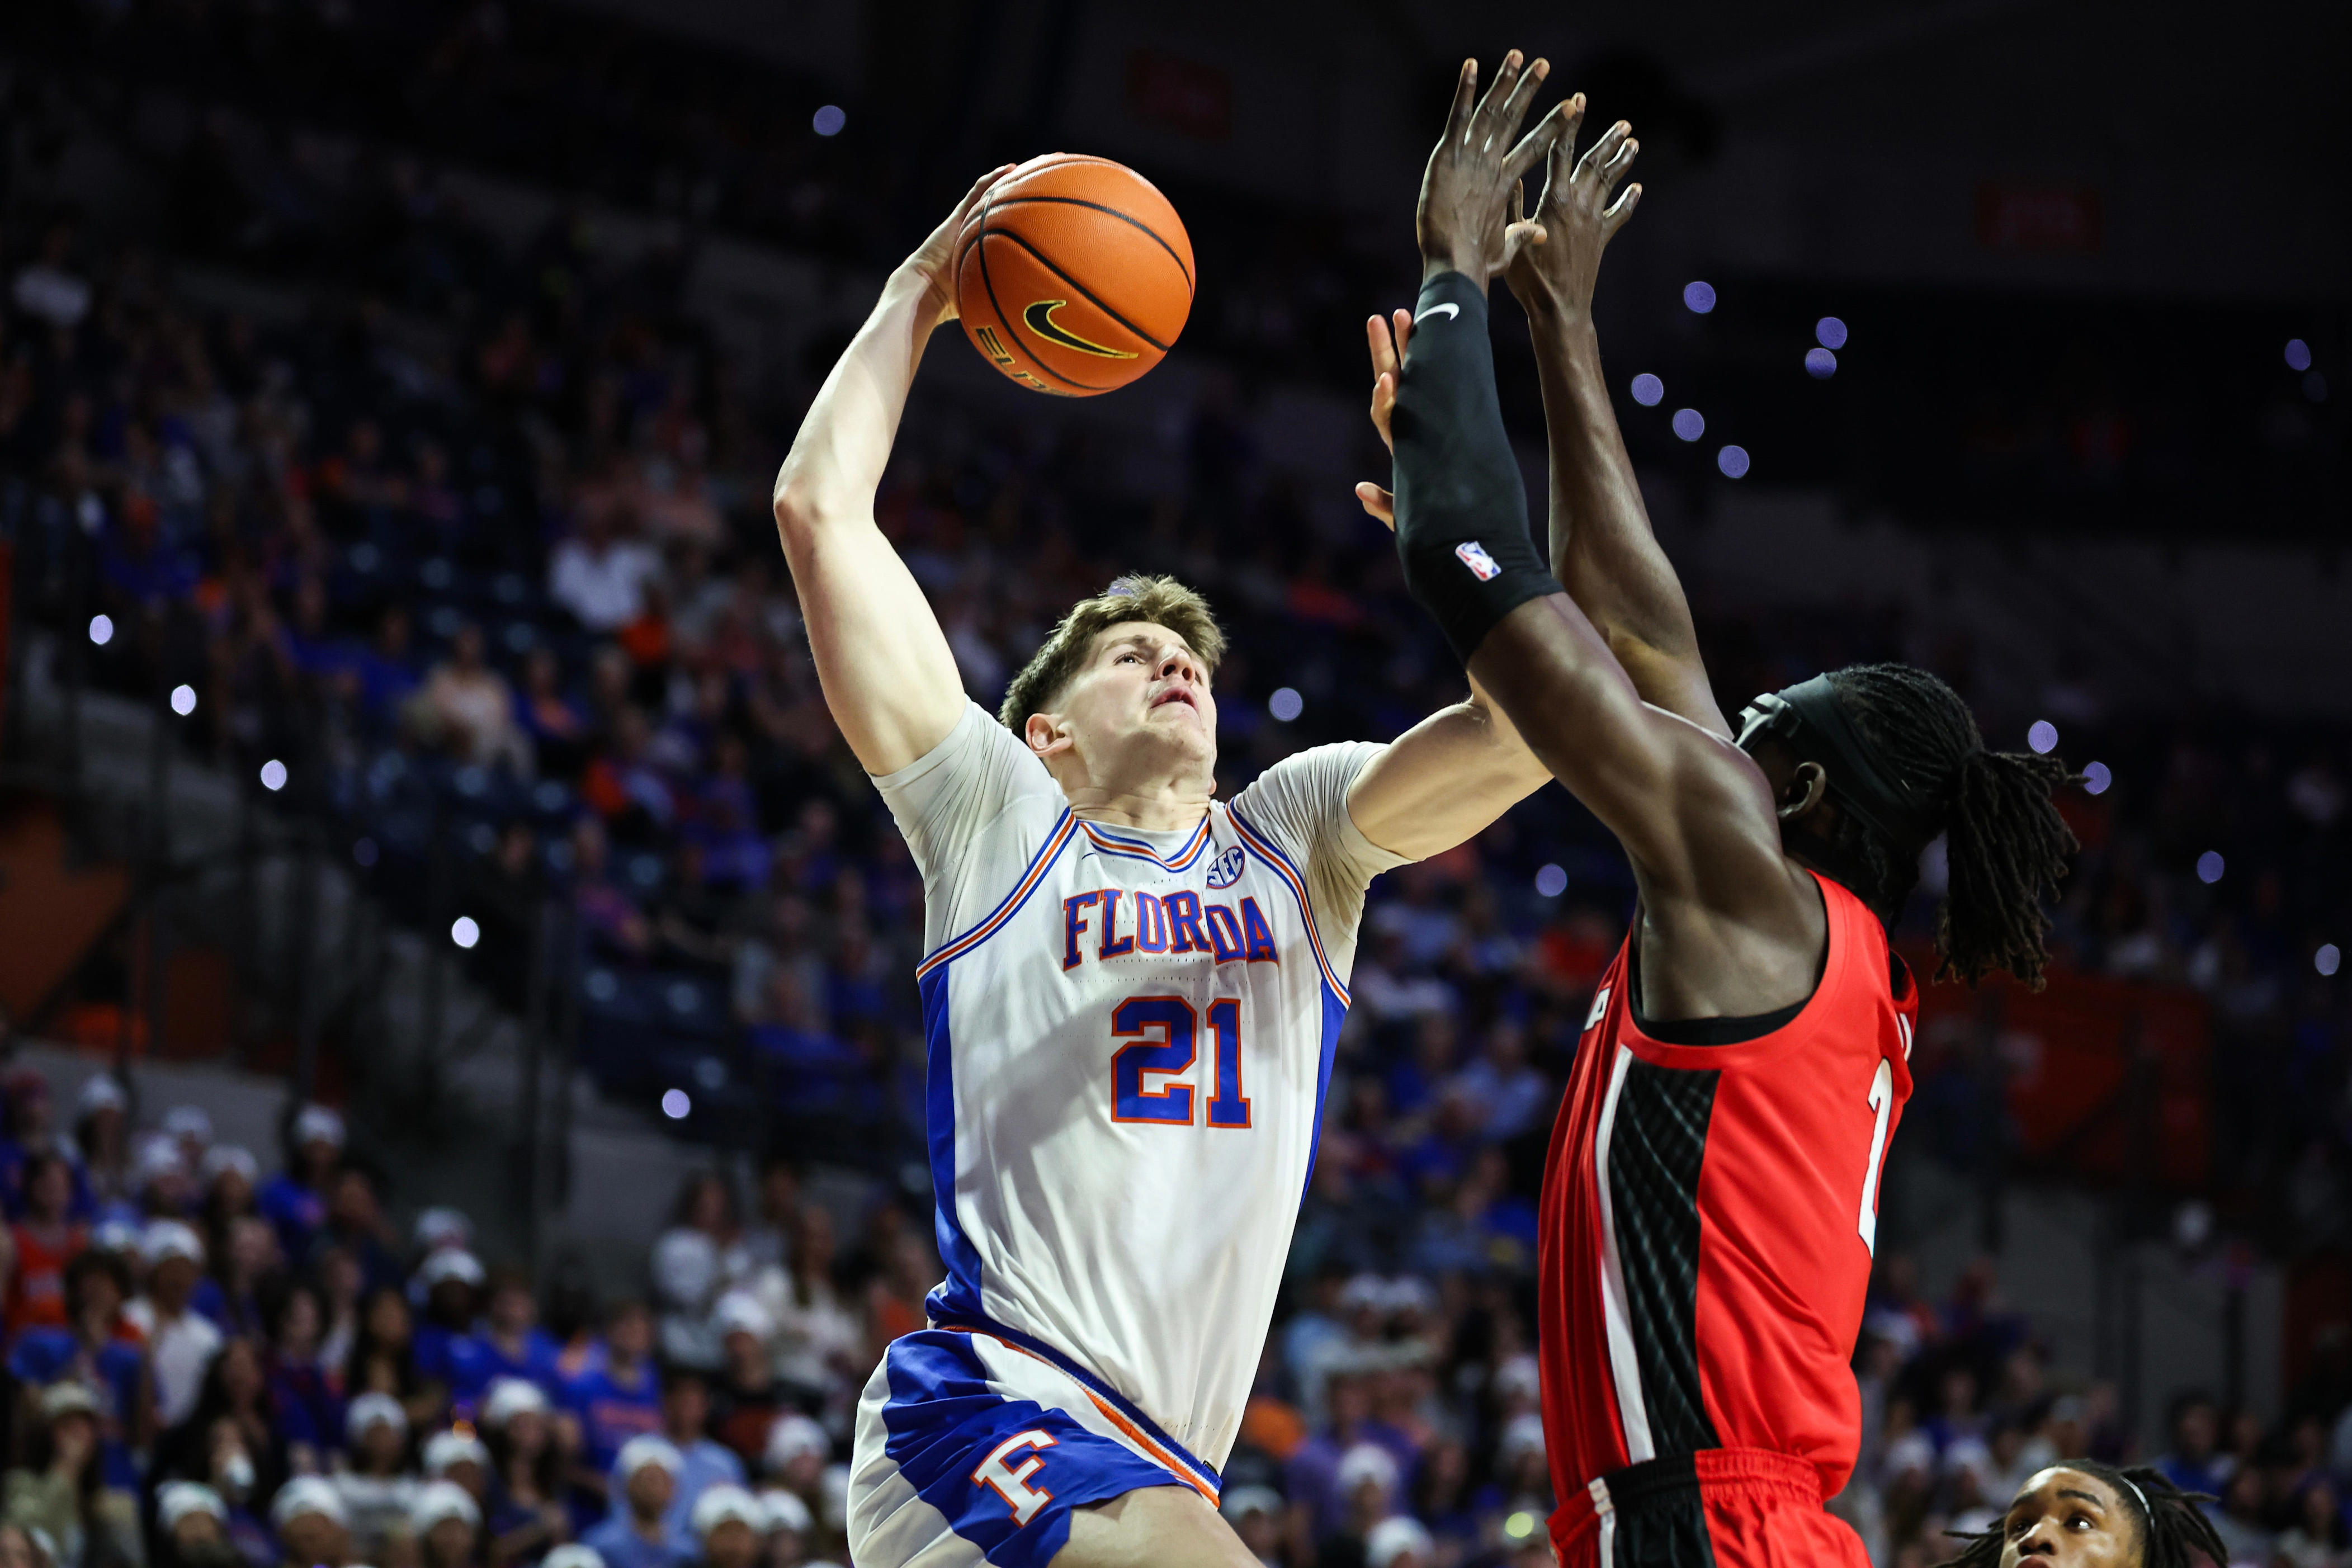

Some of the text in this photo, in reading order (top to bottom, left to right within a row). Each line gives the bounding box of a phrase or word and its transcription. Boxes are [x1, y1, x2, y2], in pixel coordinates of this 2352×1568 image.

[1207, 848, 1242, 885] SEC
[1063, 889, 1279, 971] FLORDA
[1111, 995, 1251, 1128] 21
[969, 1427, 1060, 1529] F
